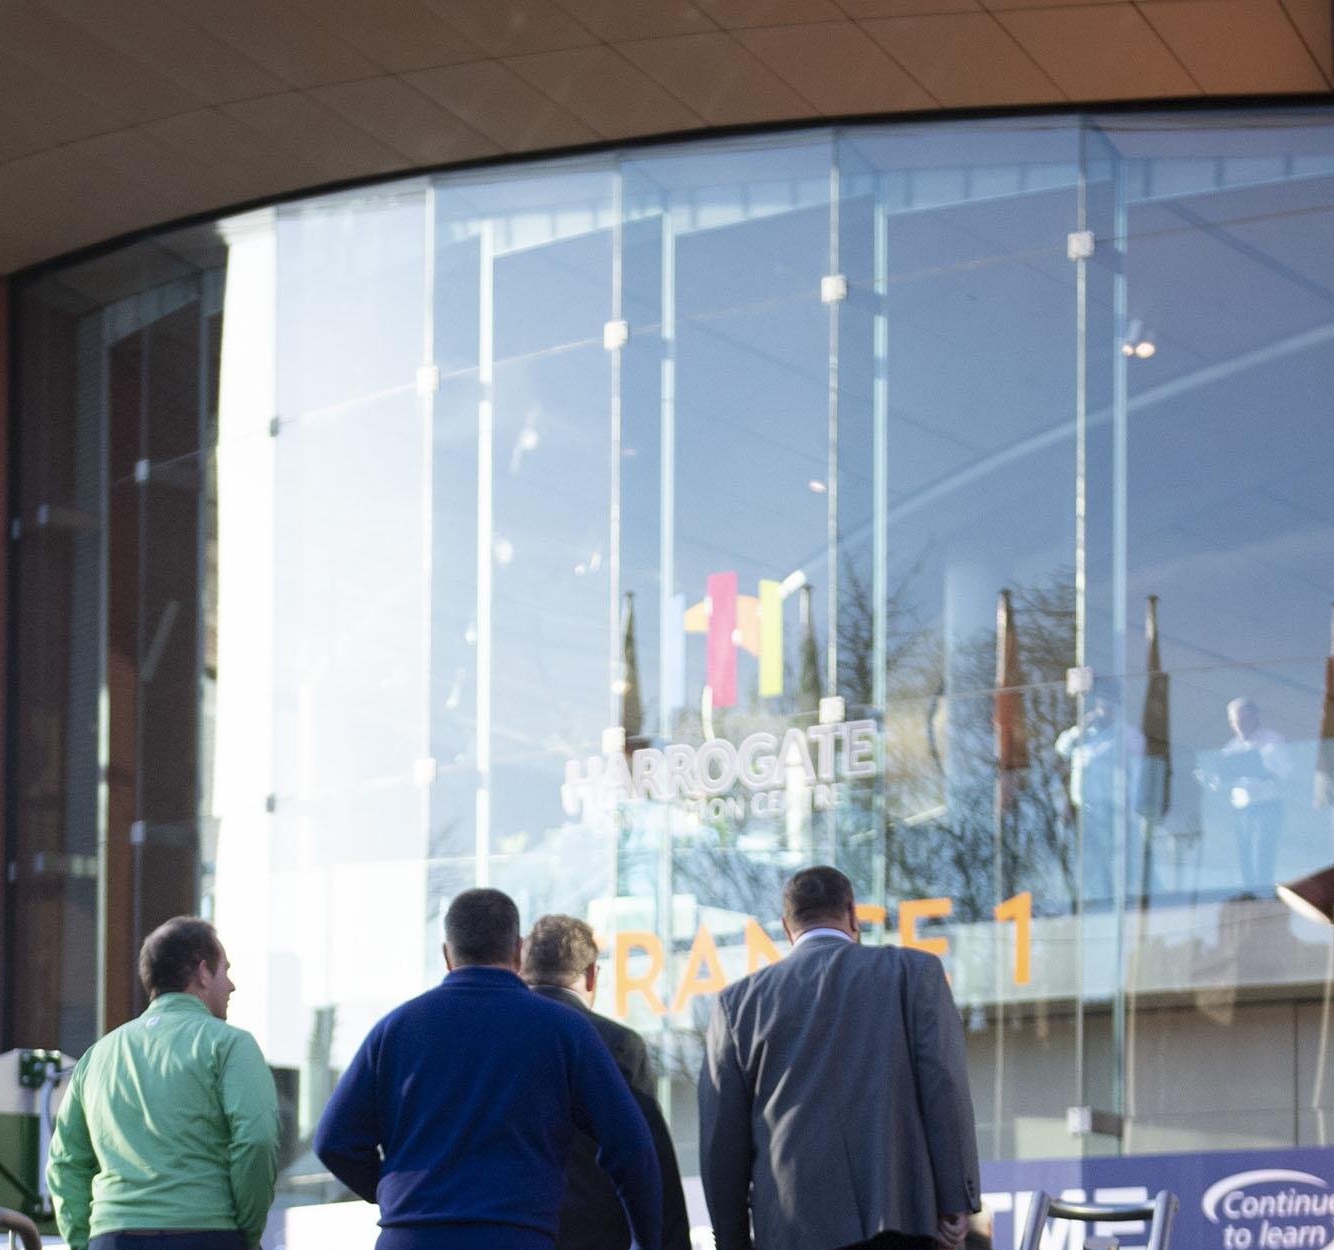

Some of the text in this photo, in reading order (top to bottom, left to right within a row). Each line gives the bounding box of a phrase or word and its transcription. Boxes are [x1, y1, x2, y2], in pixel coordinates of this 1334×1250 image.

[994, 891, 1033, 985] 1
[1223, 1220, 1325, 1250] to learn
